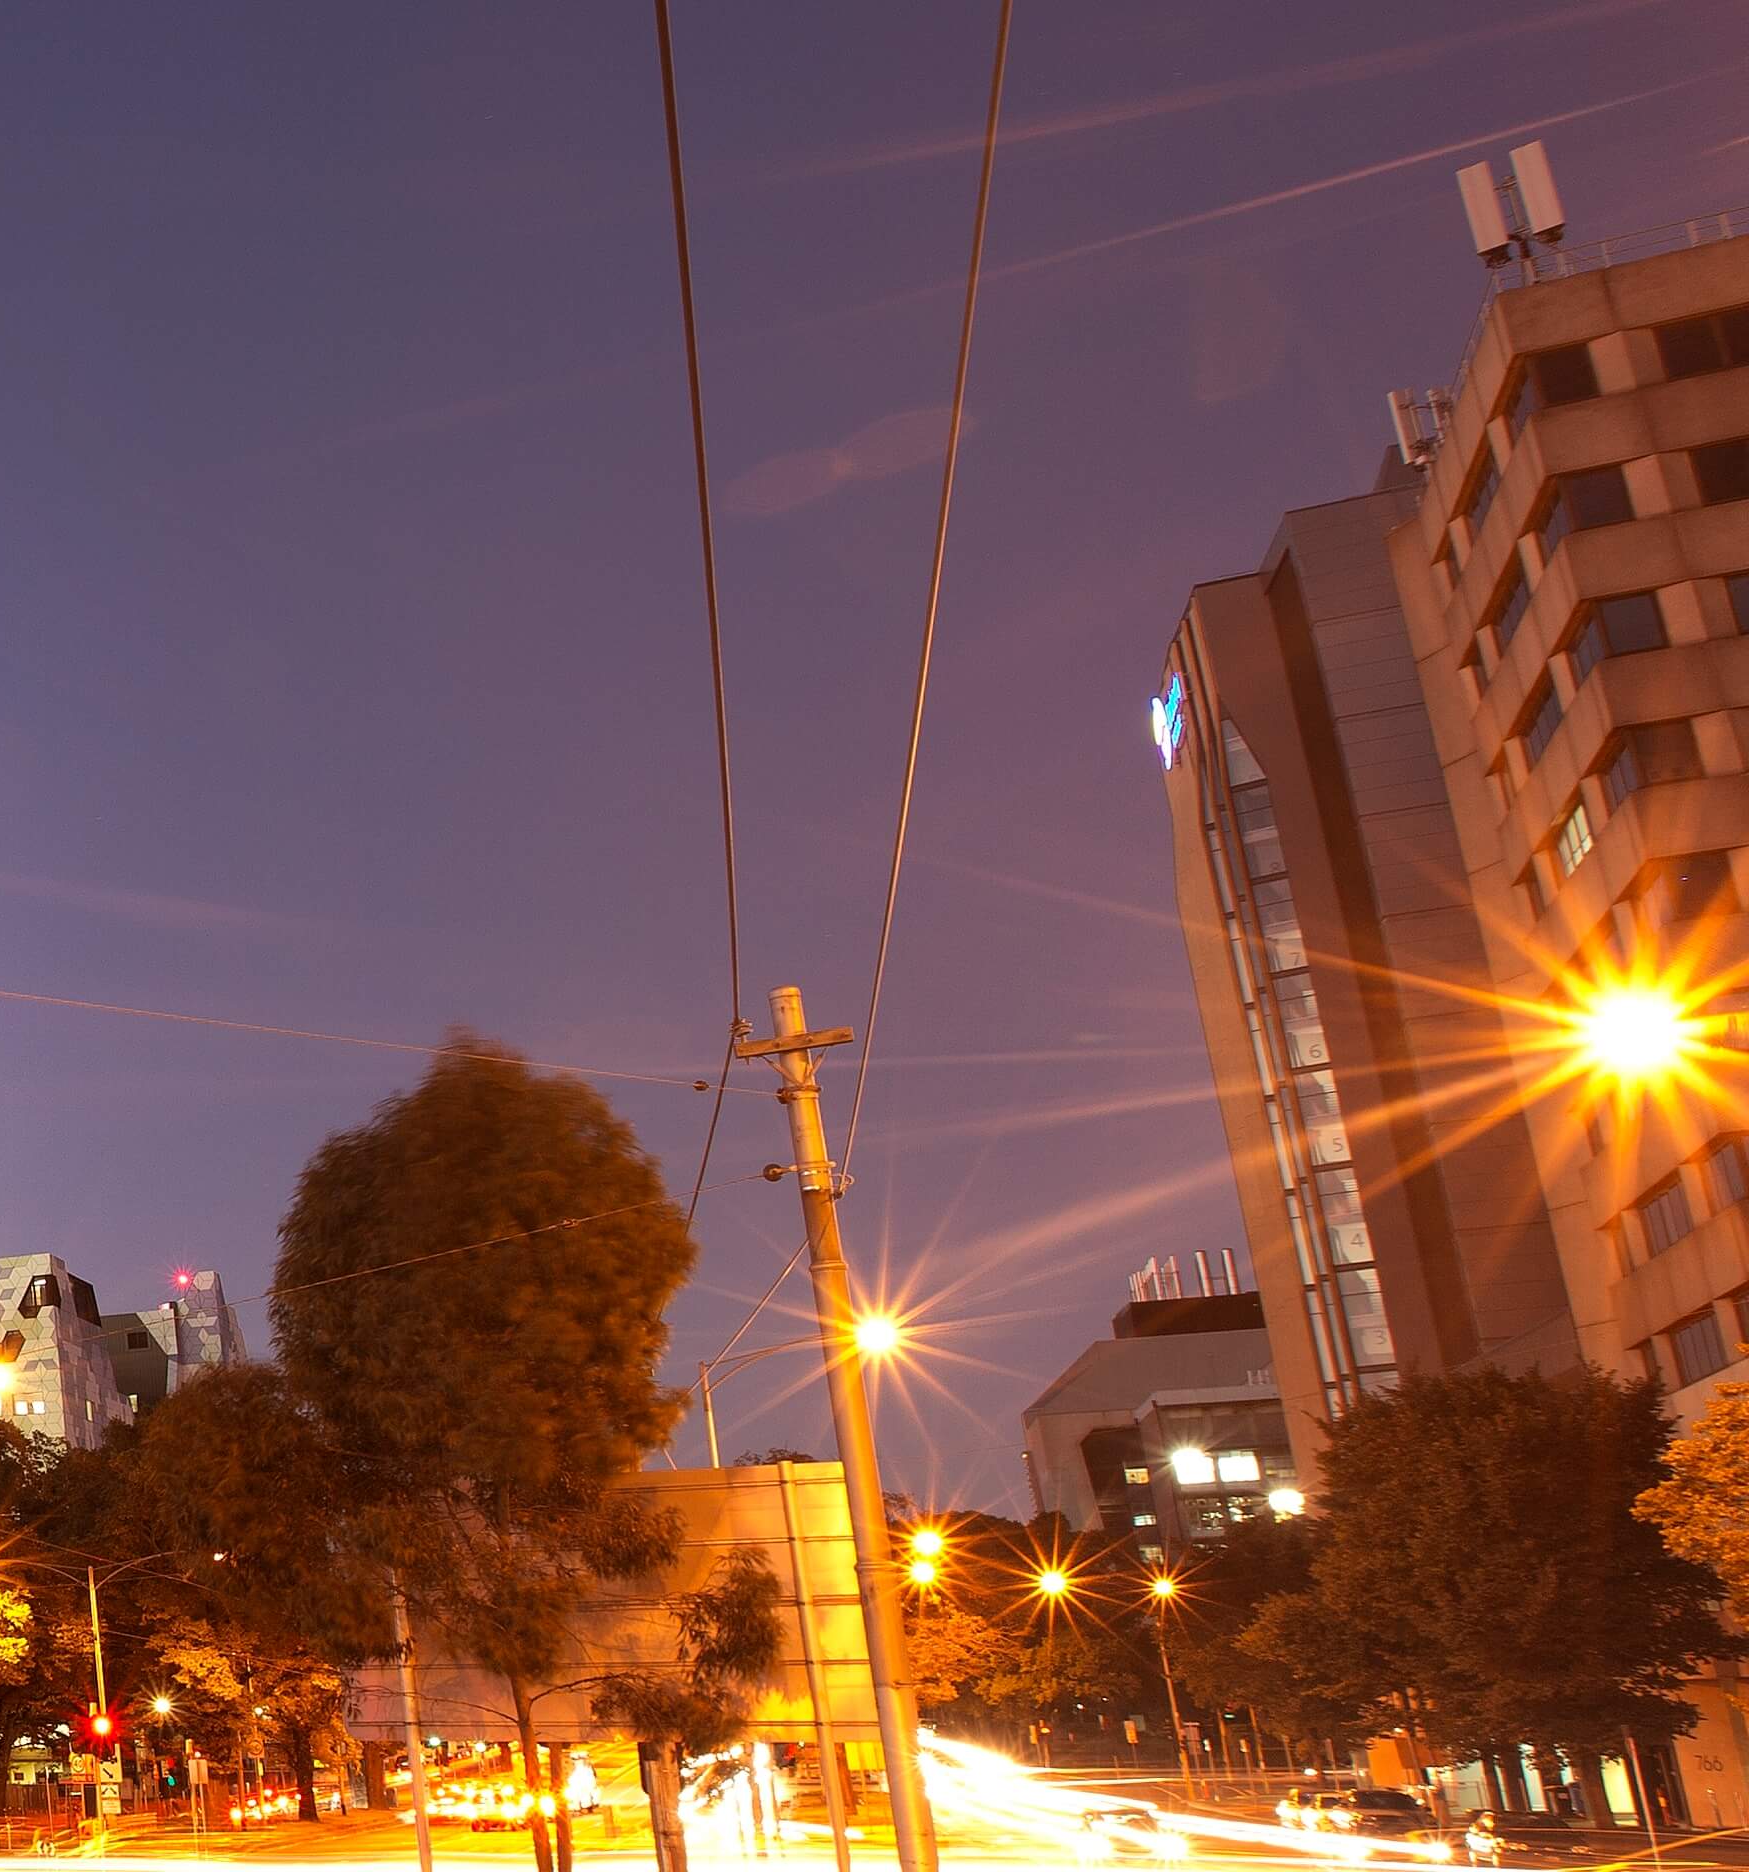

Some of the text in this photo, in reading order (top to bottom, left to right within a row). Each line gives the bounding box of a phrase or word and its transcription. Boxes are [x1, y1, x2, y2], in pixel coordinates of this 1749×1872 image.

[1288, 951, 1302, 966] 7
[1309, 1043, 1323, 1058] 6
[1332, 1136, 1344, 1152] 5
[1350, 1232, 1365, 1247] 4
[1374, 1329, 1387, 1345] 3
[1693, 1754, 1724, 1772] 766
